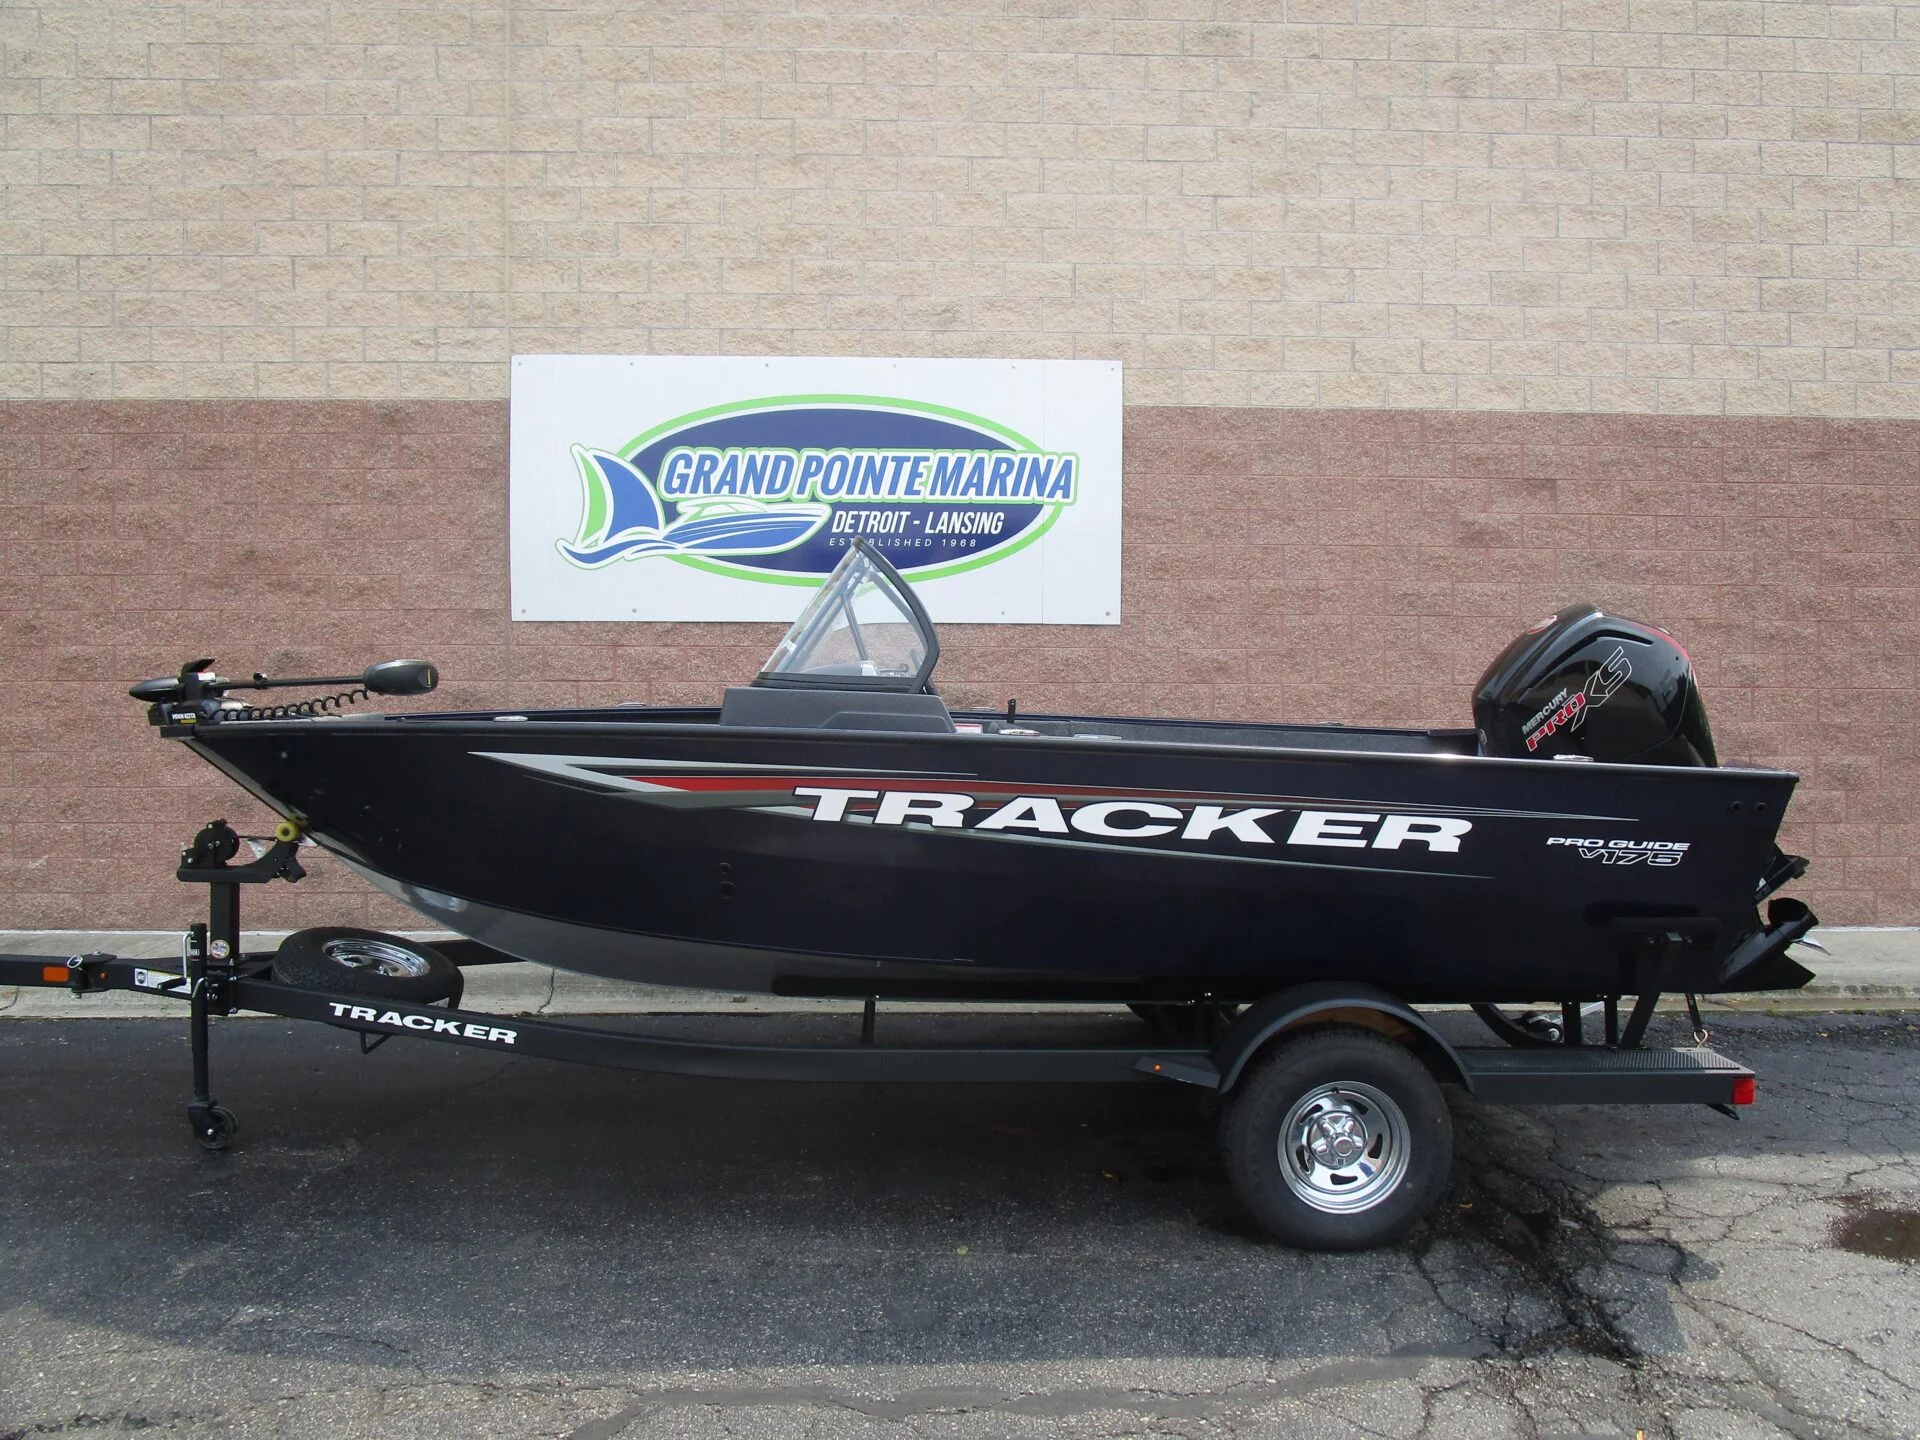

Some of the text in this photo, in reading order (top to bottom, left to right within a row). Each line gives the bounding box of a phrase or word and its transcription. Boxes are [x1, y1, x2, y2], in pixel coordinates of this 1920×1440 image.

[662, 452, 1076, 500] GRAND POINTE MARINA
[829, 537, 977, 548] ESTBLISHED 1968
[831, 510, 912, 534] DETROIT
[924, 511, 1005, 535] LANSING
[1521, 687, 1569, 735] MERCURY
[1525, 645, 1633, 752] PRO XS
[794, 786, 1473, 853] TRACKER
[1546, 837, 1691, 851] PRO GUIDE
[1578, 847, 1684, 867] V175
[329, 1002, 518, 1045] TRACKER
